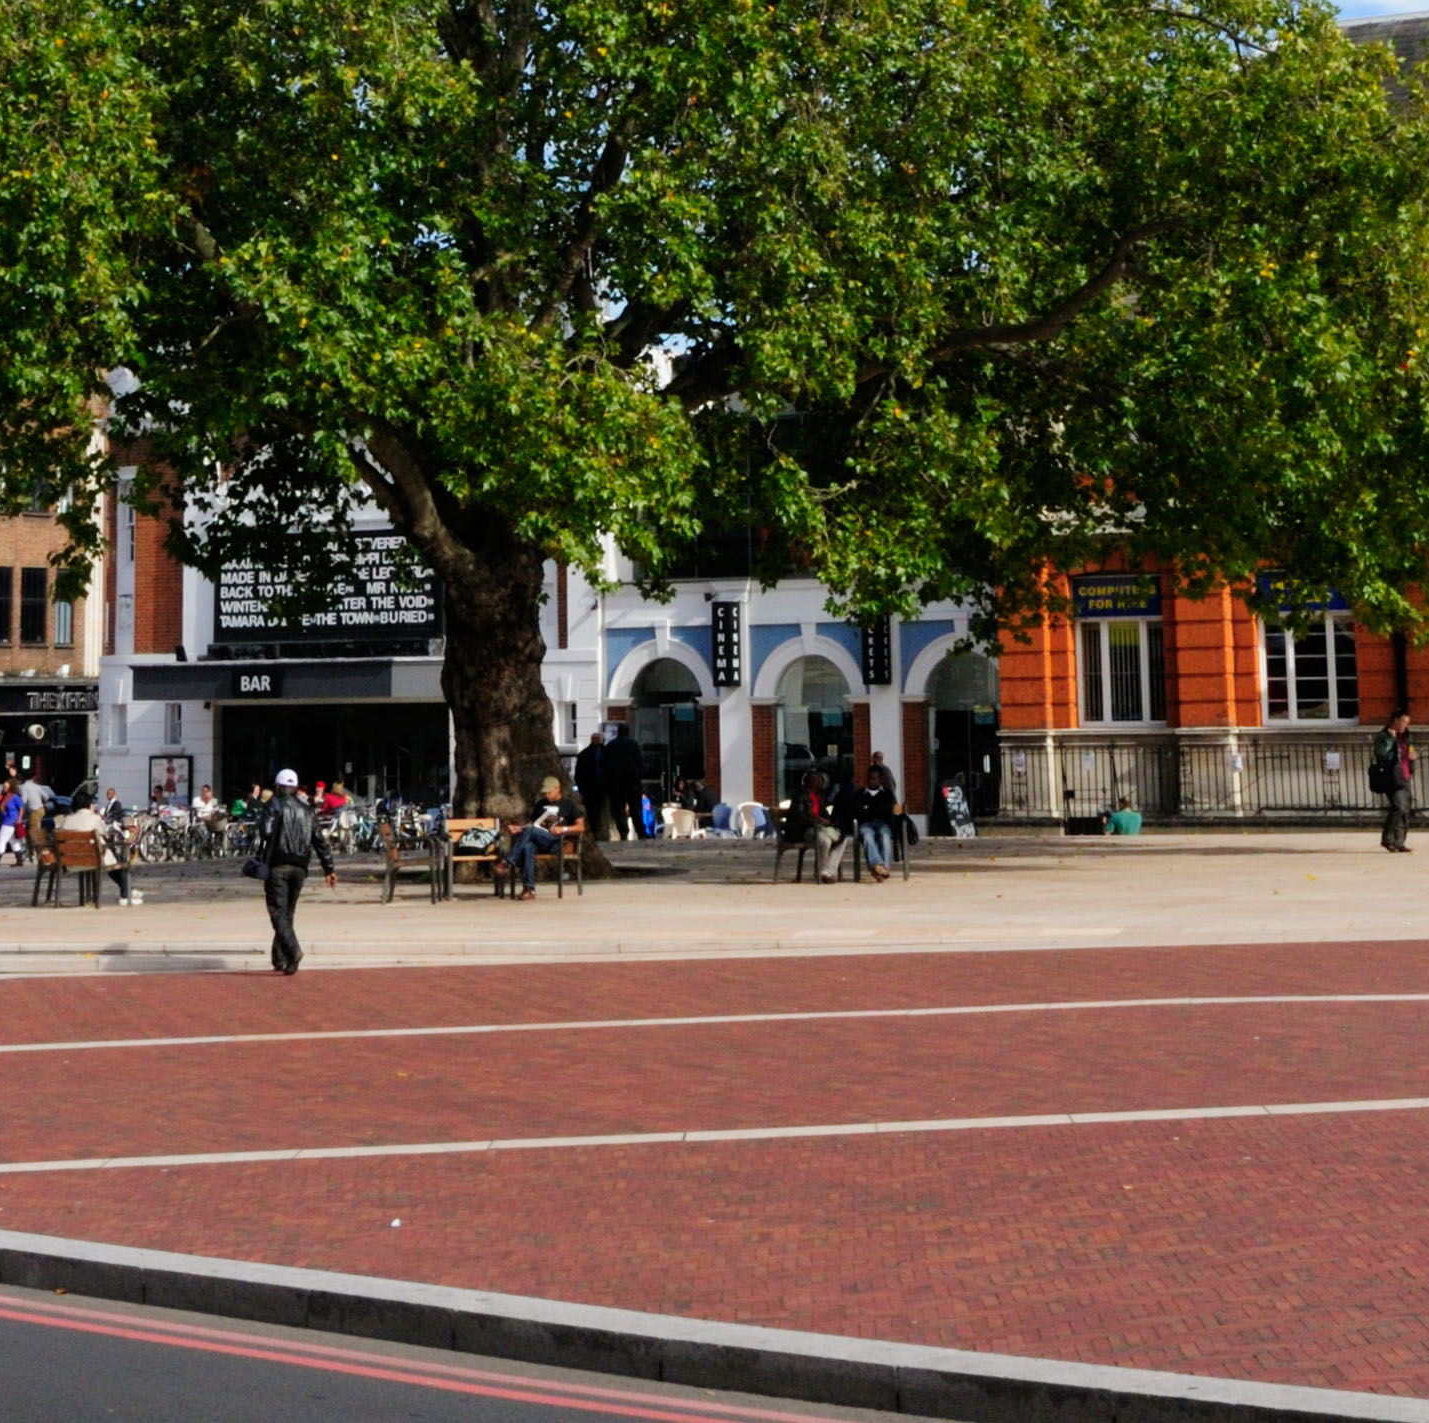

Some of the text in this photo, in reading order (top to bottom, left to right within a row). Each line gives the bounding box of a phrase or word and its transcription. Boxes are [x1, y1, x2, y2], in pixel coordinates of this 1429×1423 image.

[221, 571, 255, 585] MADE
[259, 571, 271, 584] IN
[220, 585, 253, 599] BACK
[258, 584, 274, 598] TO
[366, 581, 386, 594] MR
[370, 596, 396, 609] THE
[398, 595, 428, 608] VOID
[1088, 599, 1113, 610] FOR
[219, 615, 265, 628] TAMARA
[315, 612, 337, 625] THE
[340, 611, 374, 625] TOWN
[380, 610, 427, 624] BURIED
[717, 607, 727, 682] CINEMA
[732, 606, 740, 681] CINEMA
[240, 675, 272, 692] BAR
